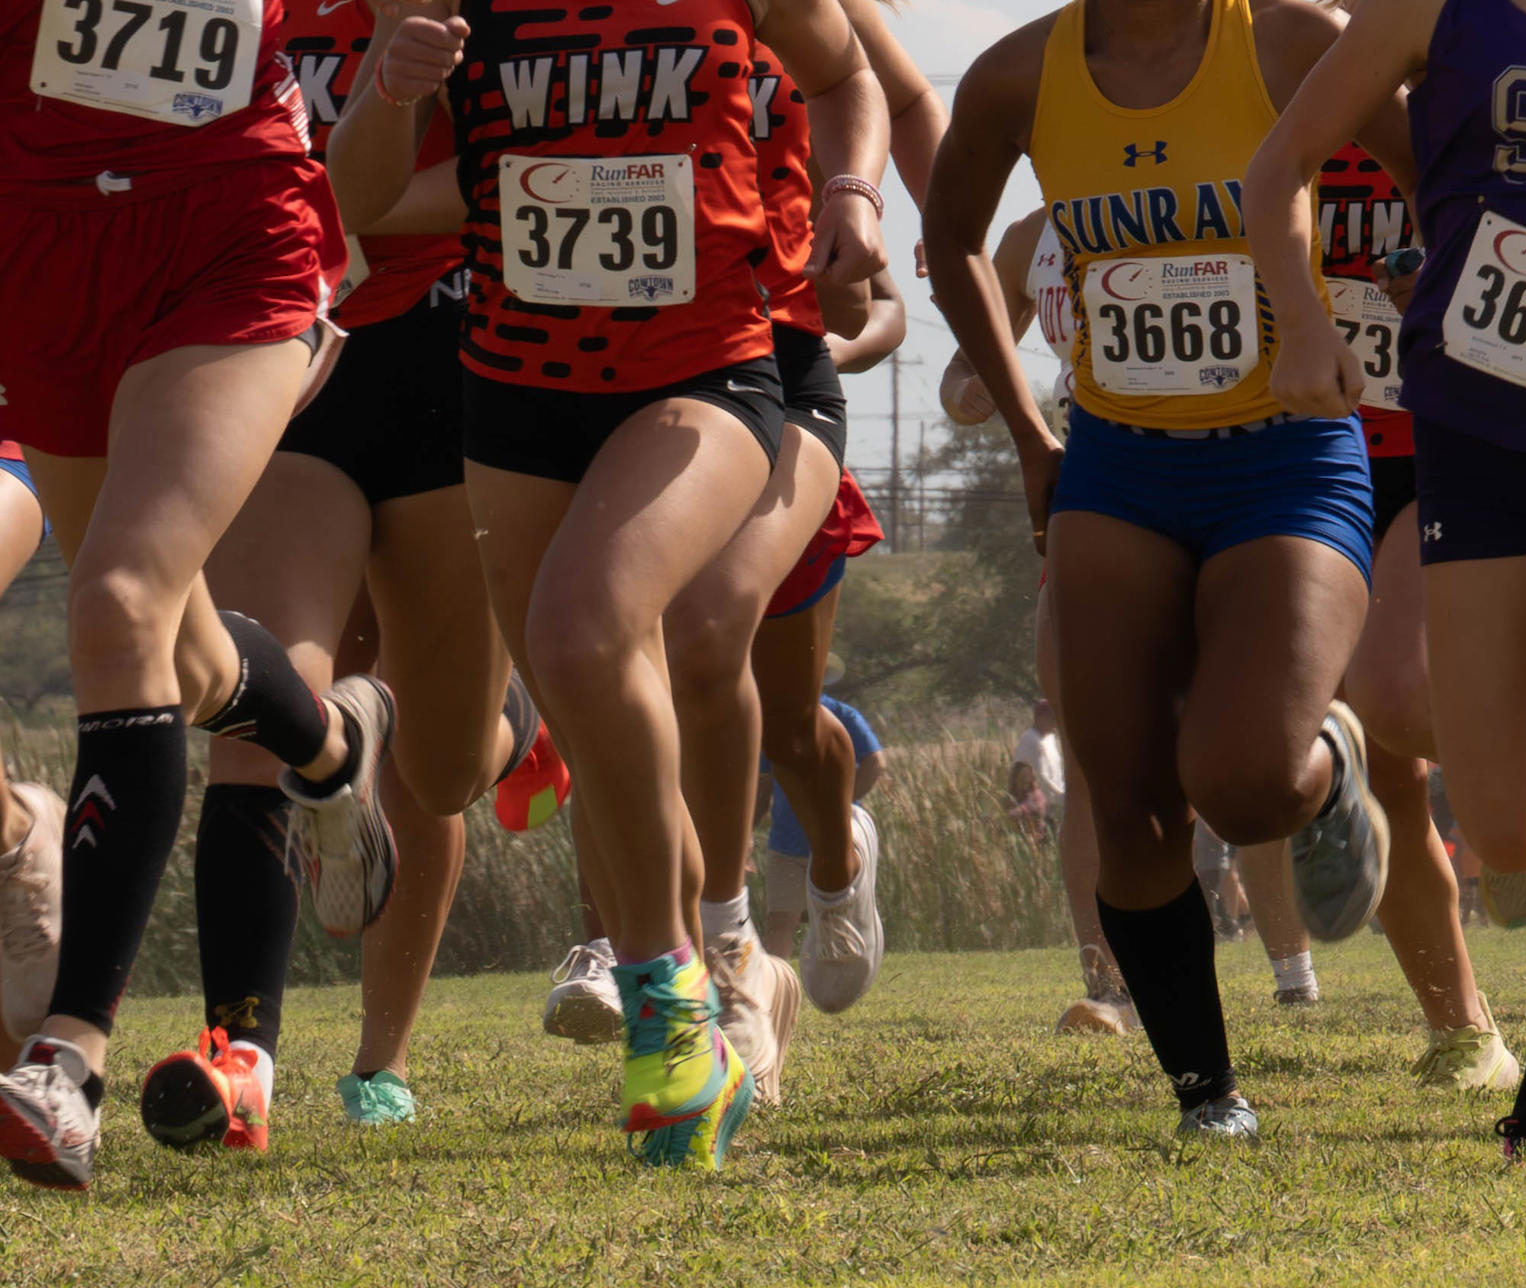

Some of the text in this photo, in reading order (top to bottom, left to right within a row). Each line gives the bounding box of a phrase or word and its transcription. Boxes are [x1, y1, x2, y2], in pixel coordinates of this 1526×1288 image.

[499, 47, 704, 130] WINK
[591, 163, 665, 181] RunFAR
[515, 205, 678, 272] 3739
[1052, 179, 1249, 255] SUNRAY
[1162, 261, 1229, 278] RunFAR
[1100, 300, 1243, 363] 3668
